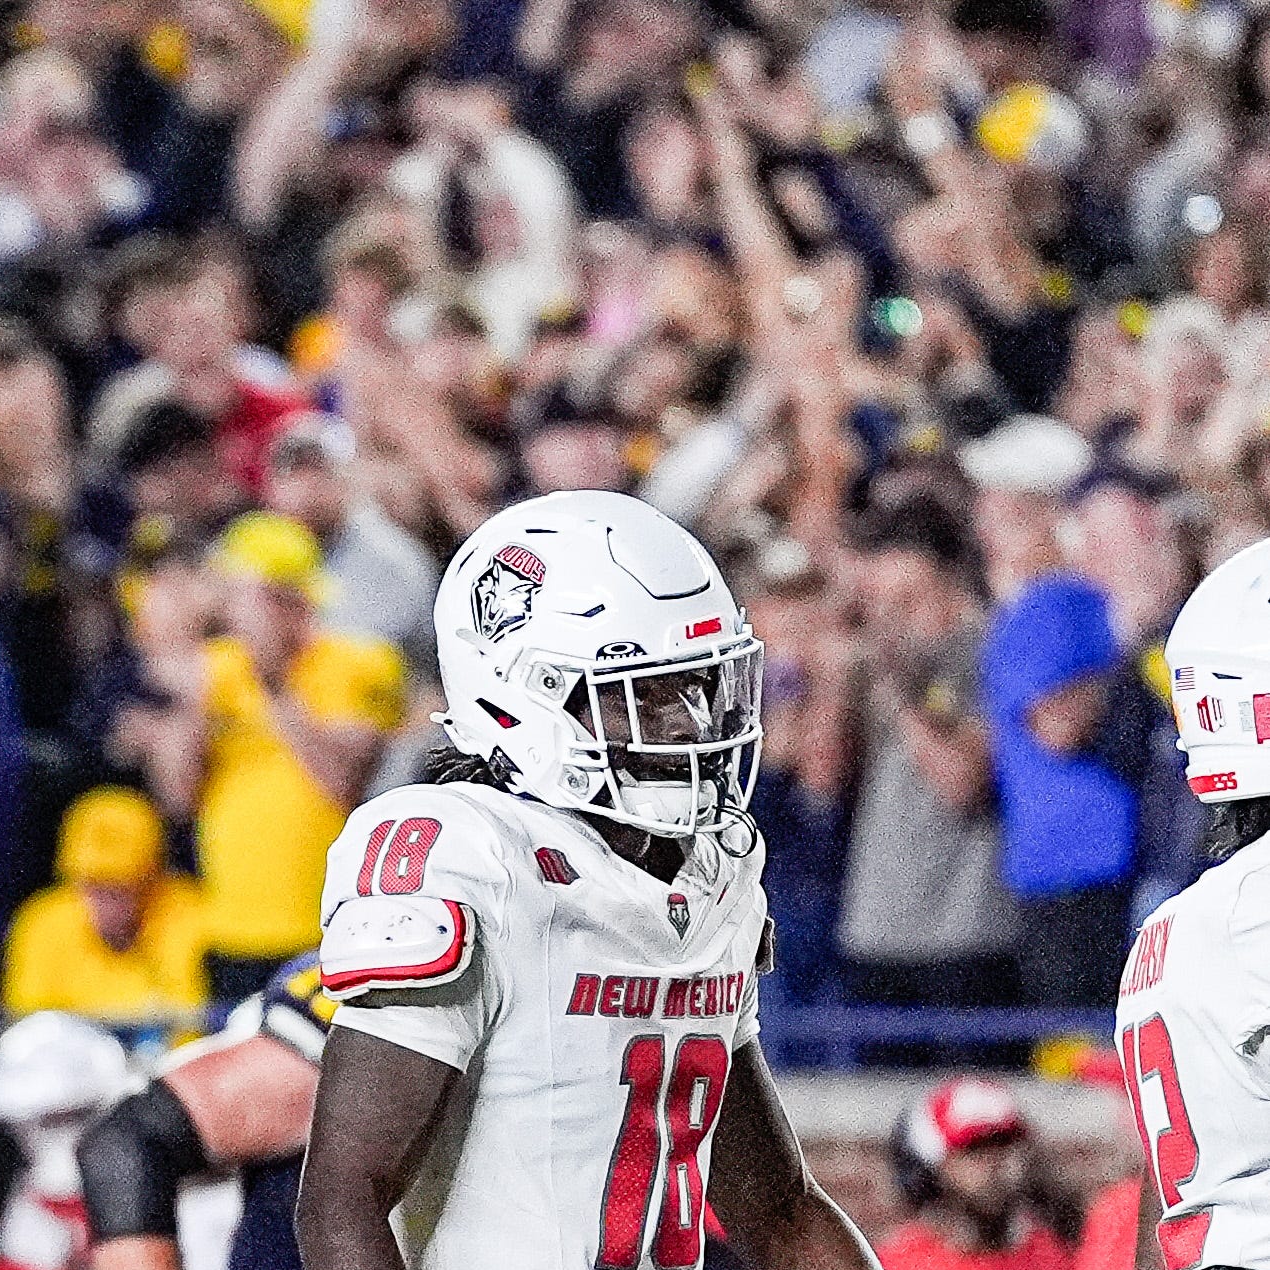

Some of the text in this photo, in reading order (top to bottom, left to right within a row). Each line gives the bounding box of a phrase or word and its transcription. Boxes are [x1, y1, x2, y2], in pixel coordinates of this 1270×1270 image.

[494, 546, 546, 585] LOBOS
[357, 817, 442, 897] 18
[565, 973, 660, 1018] NEW
